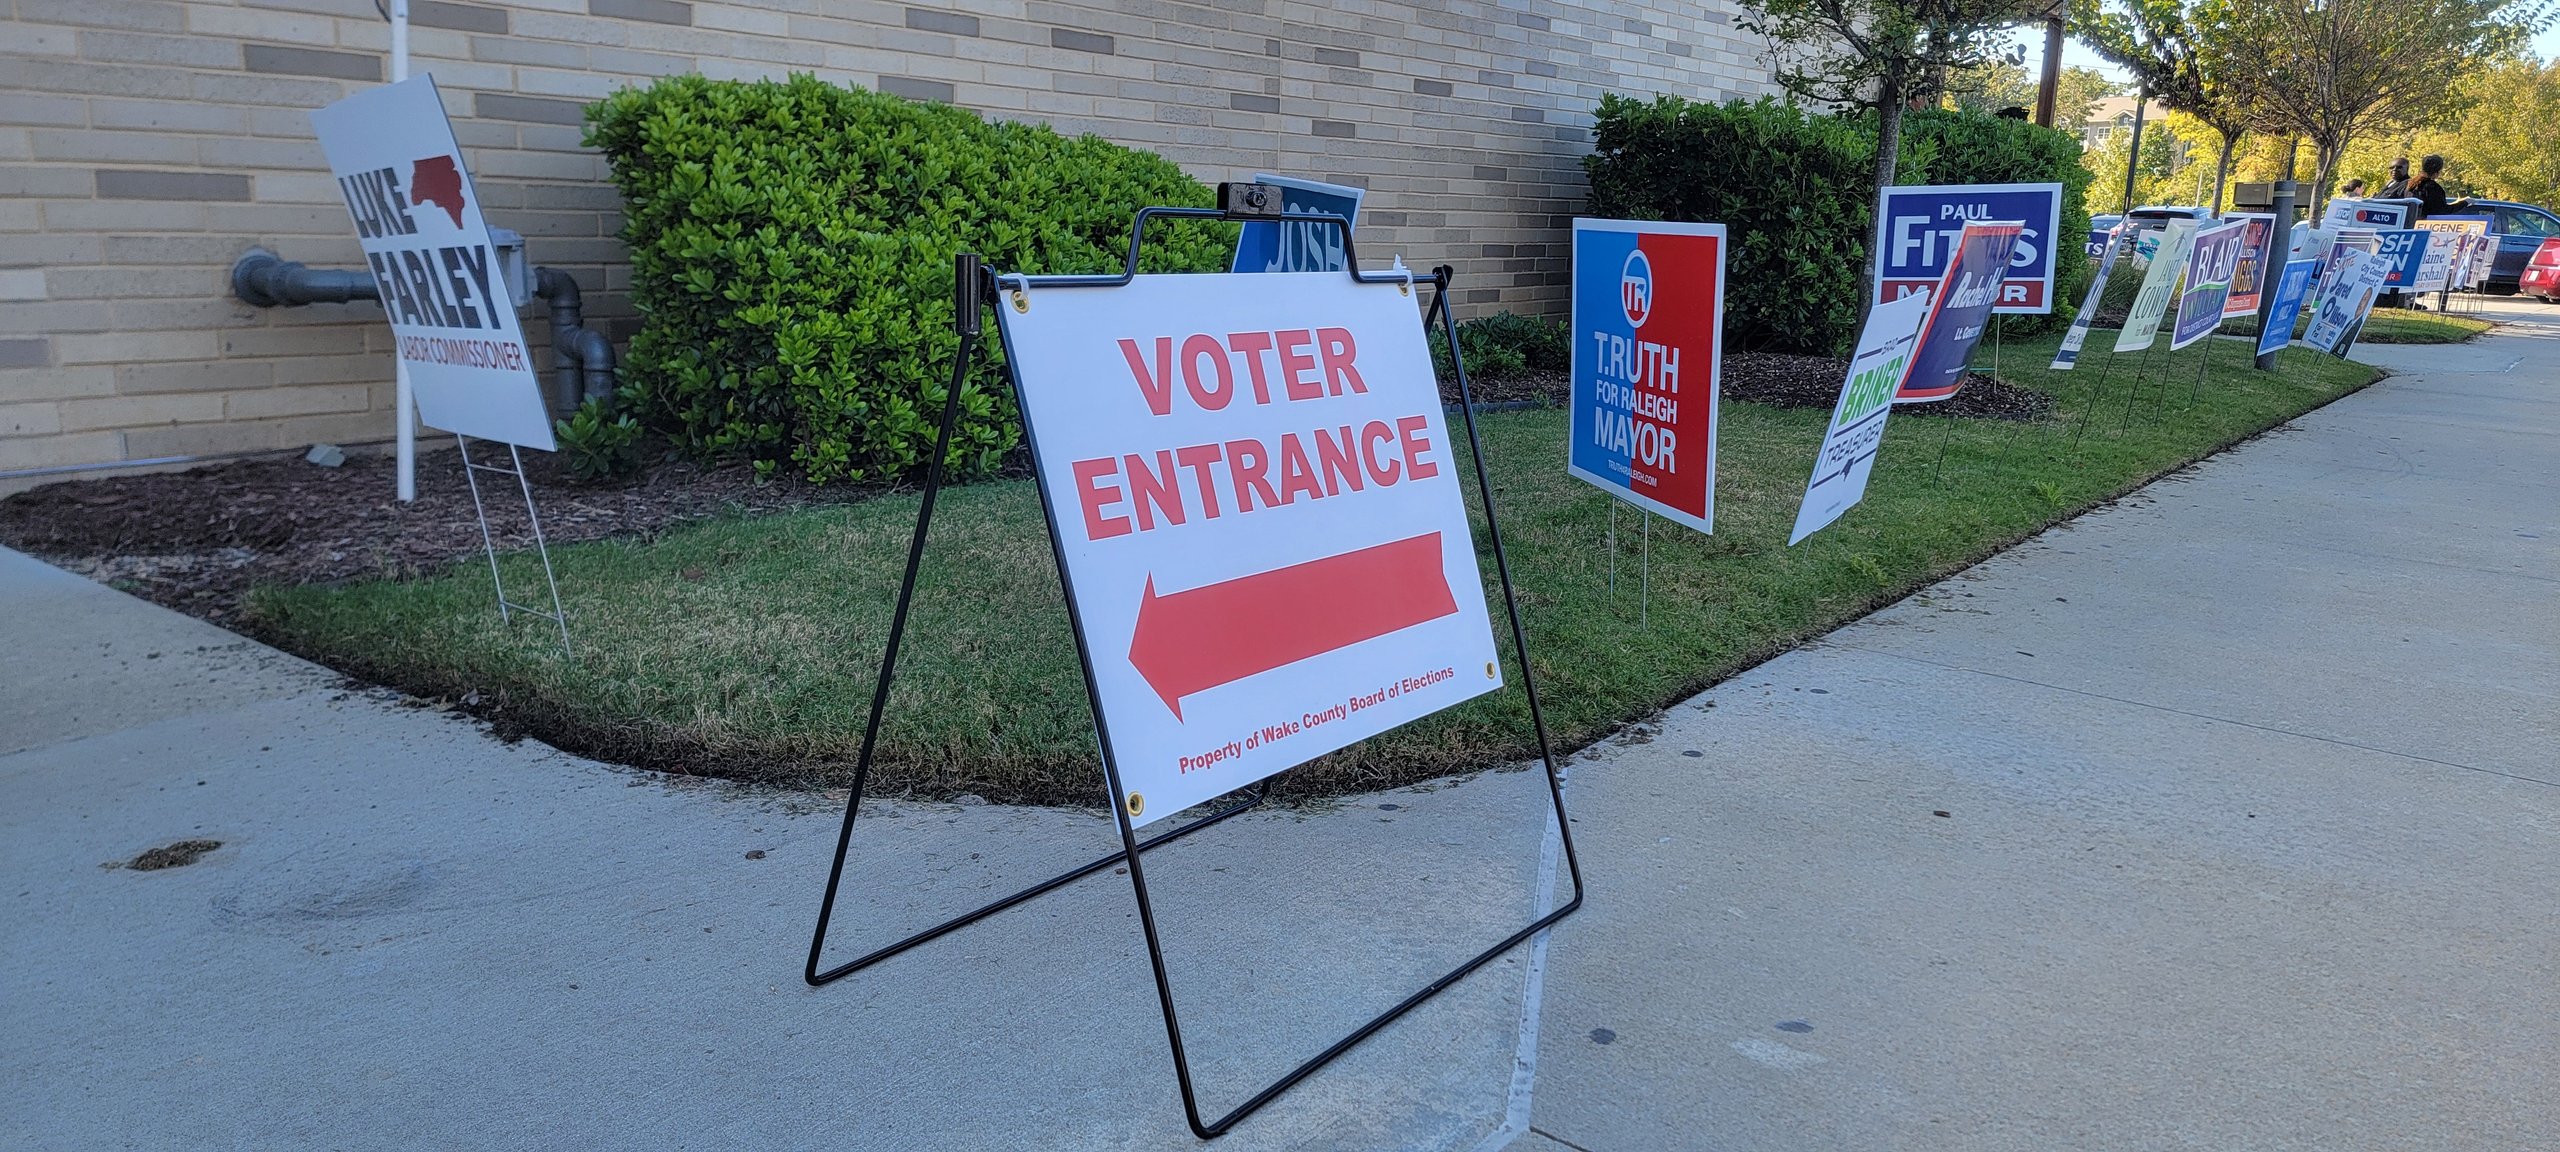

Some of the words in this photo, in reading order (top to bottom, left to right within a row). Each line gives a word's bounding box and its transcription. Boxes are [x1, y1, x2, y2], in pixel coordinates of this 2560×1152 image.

[339, 167, 418, 239] LUKE
[1941, 204, 1993, 220] PAUL
[2372, 214, 2390, 222] ALTO
[2417, 224, 2464, 233] EUGENE
[1265, 200, 1345, 272] JOSH
[1892, 216, 2039, 267] FITS
[2422, 249, 2445, 264] laine
[368, 245, 502, 330] FARLEY
[2194, 236, 2240, 288] BLAIR
[2329, 270, 2354, 300] Jared
[1946, 271, 1993, 309] Rachel
[2322, 296, 2348, 329] Ollison
[399, 335, 433, 362] LABOR
[430, 337, 526, 371] COMMISSIONER
[1117, 327, 1369, 416] VOTER
[1594, 331, 1680, 394] T.RUTH
[1596, 380, 1618, 408] FOR
[1621, 388, 1677, 425] RALEIGH
[1837, 355, 1904, 427] BRINER
[1594, 407, 1676, 474] MAYOR
[1824, 420, 1884, 469] TREASURER
[1071, 415, 1440, 542] ENTRANCE
[1179, 740, 1242, 774] Property
[1246, 731, 1259, 750] of
[1261, 721, 1300, 744] Wake
[1302, 702, 1347, 729] County
[1349, 688, 1385, 713] Board
[1388, 682, 1400, 699] of
[1401, 666, 1455, 694] Elections
